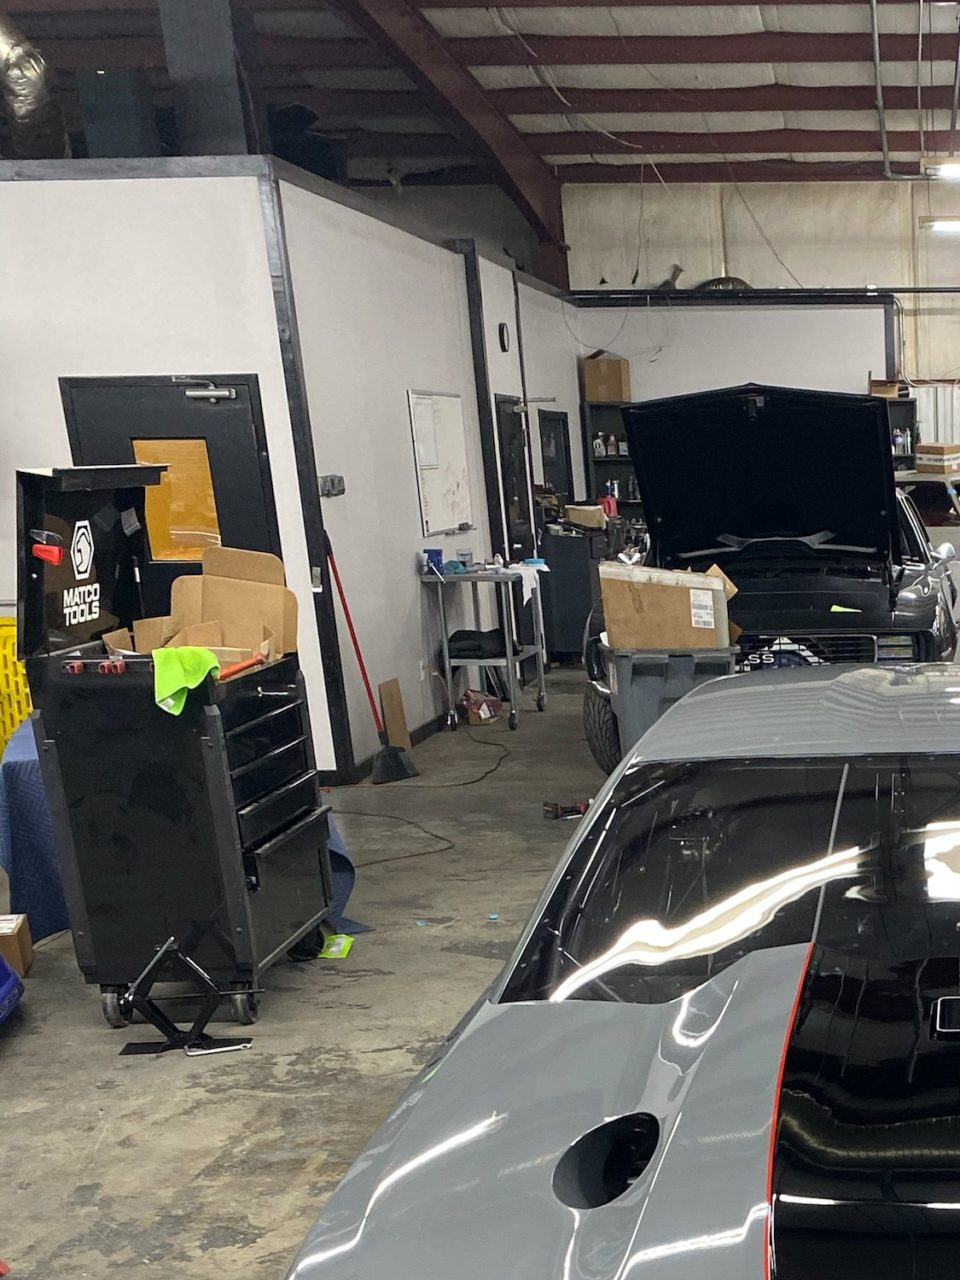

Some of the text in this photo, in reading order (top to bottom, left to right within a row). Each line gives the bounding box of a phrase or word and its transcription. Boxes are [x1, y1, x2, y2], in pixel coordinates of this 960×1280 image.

[63, 582, 100, 608] MATCO
[63, 600, 100, 627] TOOLS
[748, 653, 775, 664] SS
